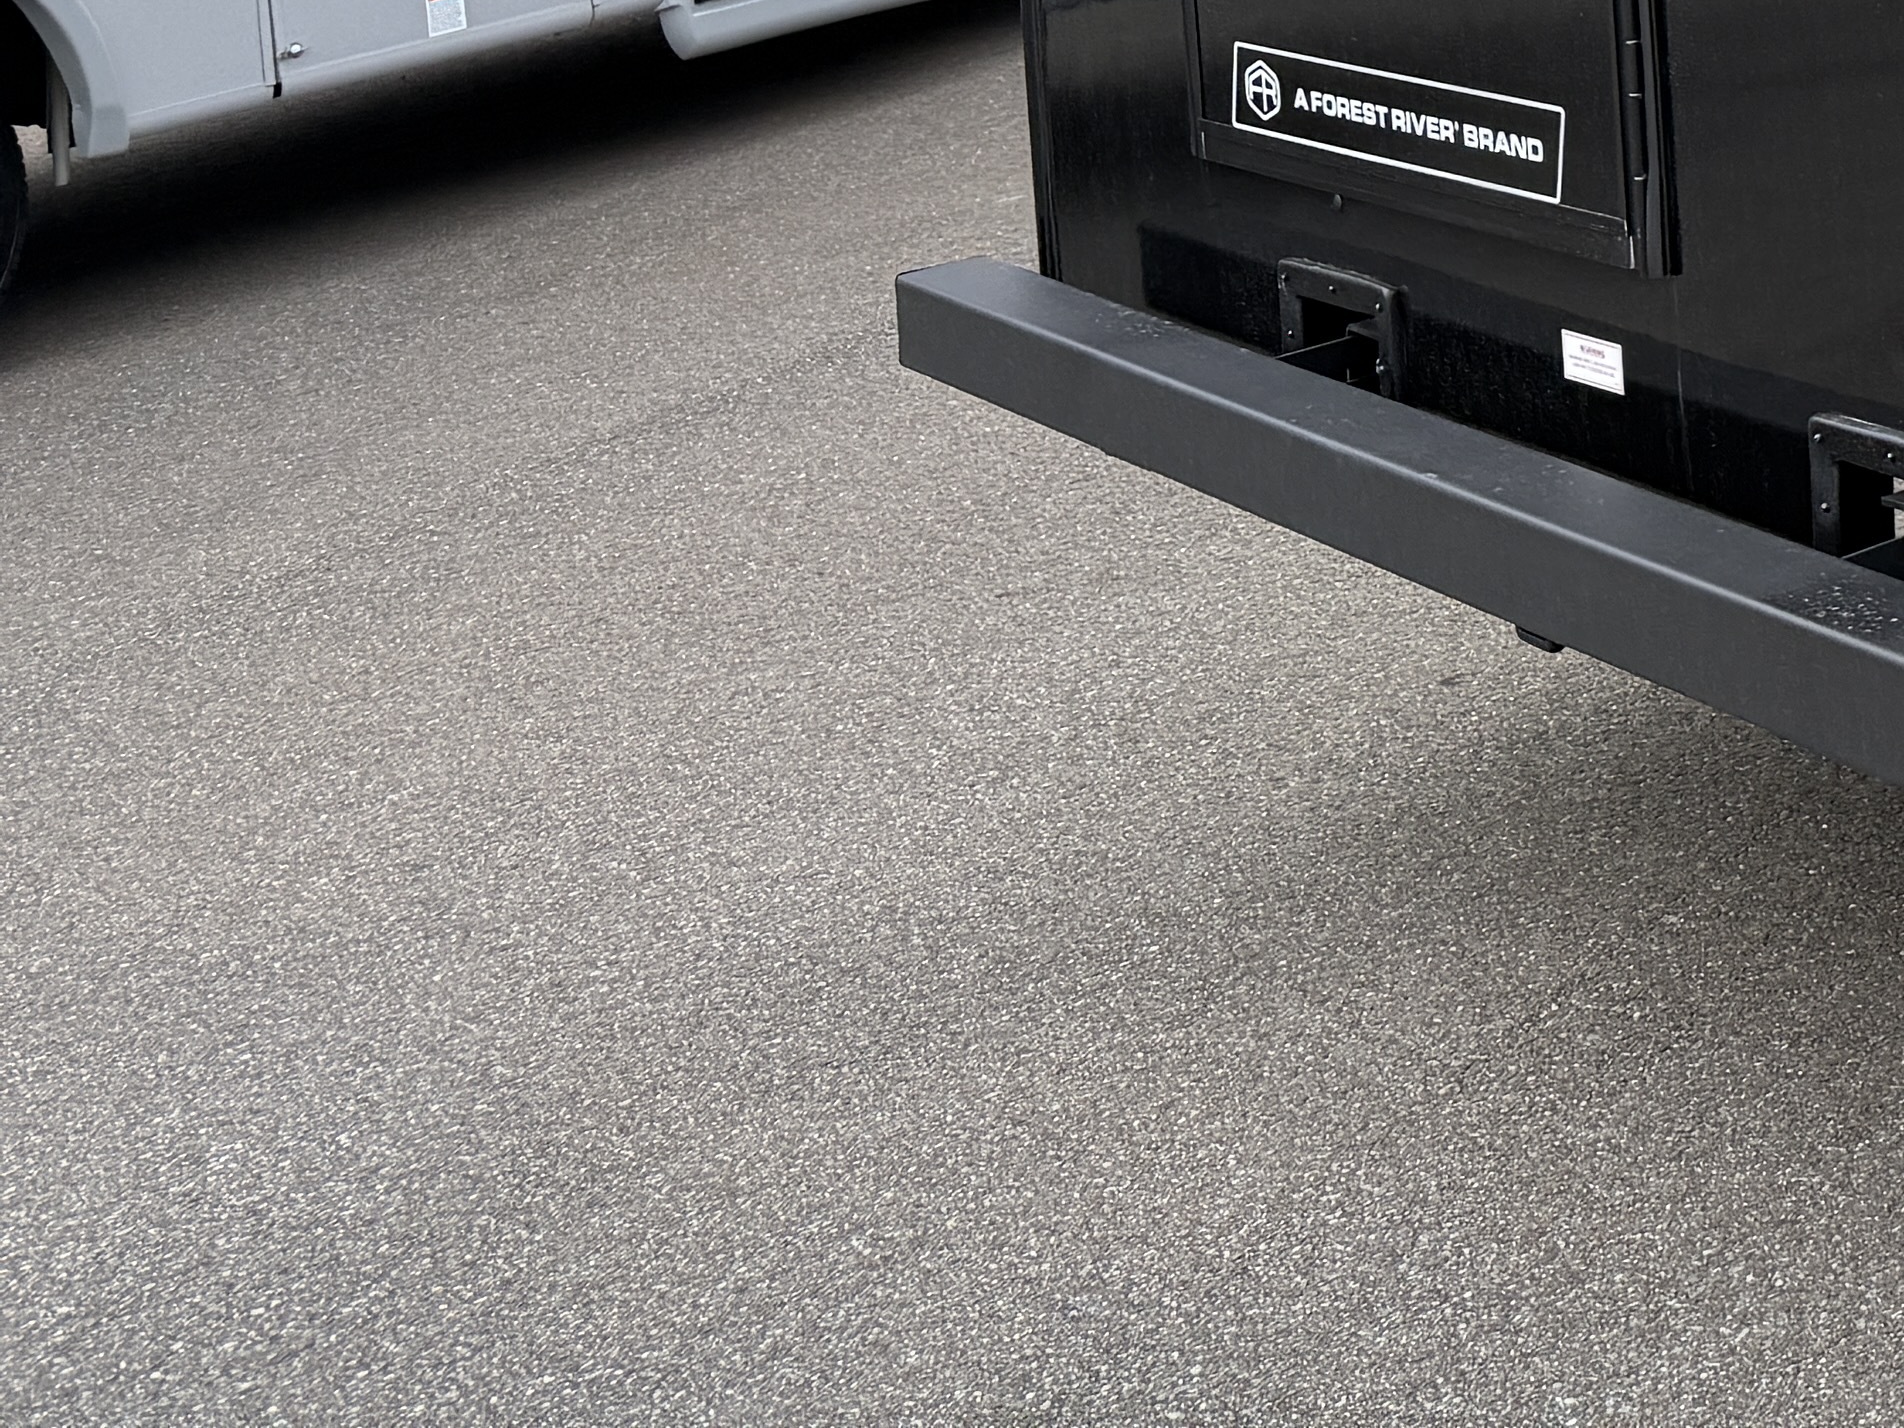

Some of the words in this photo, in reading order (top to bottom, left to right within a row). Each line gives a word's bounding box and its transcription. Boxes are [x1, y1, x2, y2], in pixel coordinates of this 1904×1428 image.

[1294, 88, 1309, 111] A
[1310, 90, 1388, 129] FOREST
[1463, 123, 1544, 163] BRAND
